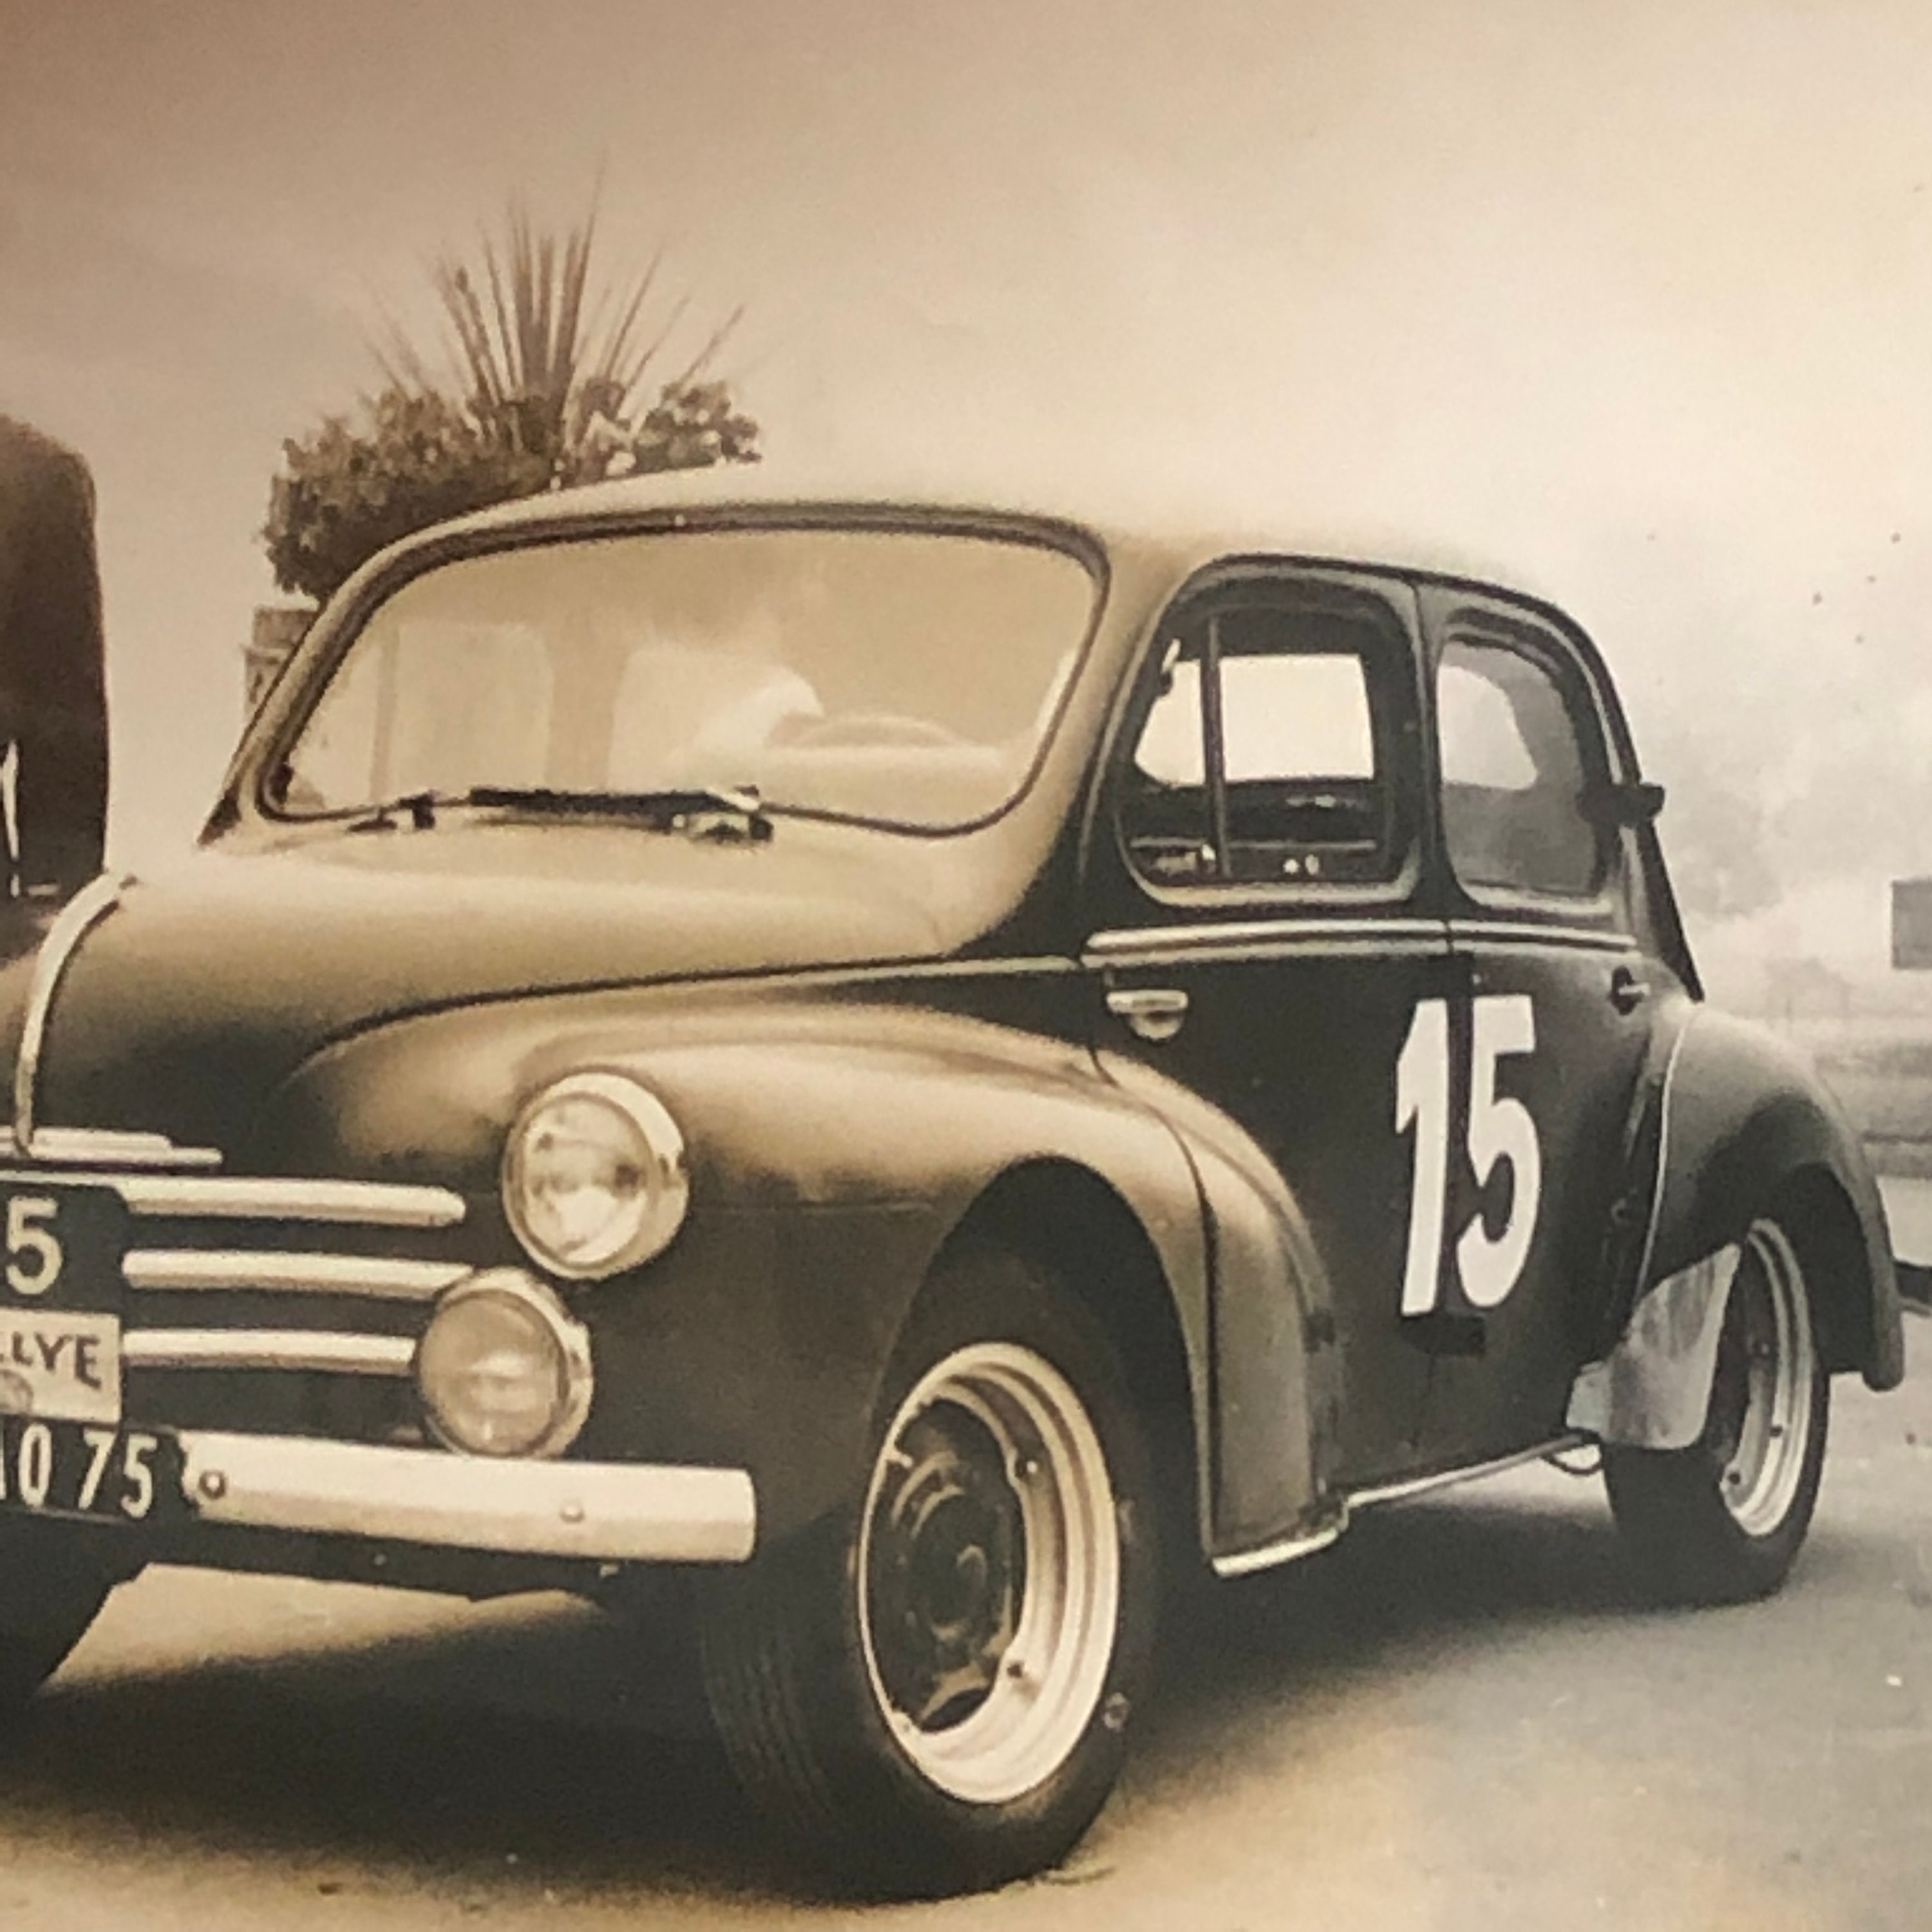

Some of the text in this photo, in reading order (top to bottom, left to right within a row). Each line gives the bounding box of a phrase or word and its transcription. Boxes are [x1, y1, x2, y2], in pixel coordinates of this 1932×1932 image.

[1396, 994, 1540, 1315] 15
[6, 1196, 62, 1294] 5
[0, 1331, 101, 1389] LYE
[79, 1427, 158, 1518] 75
